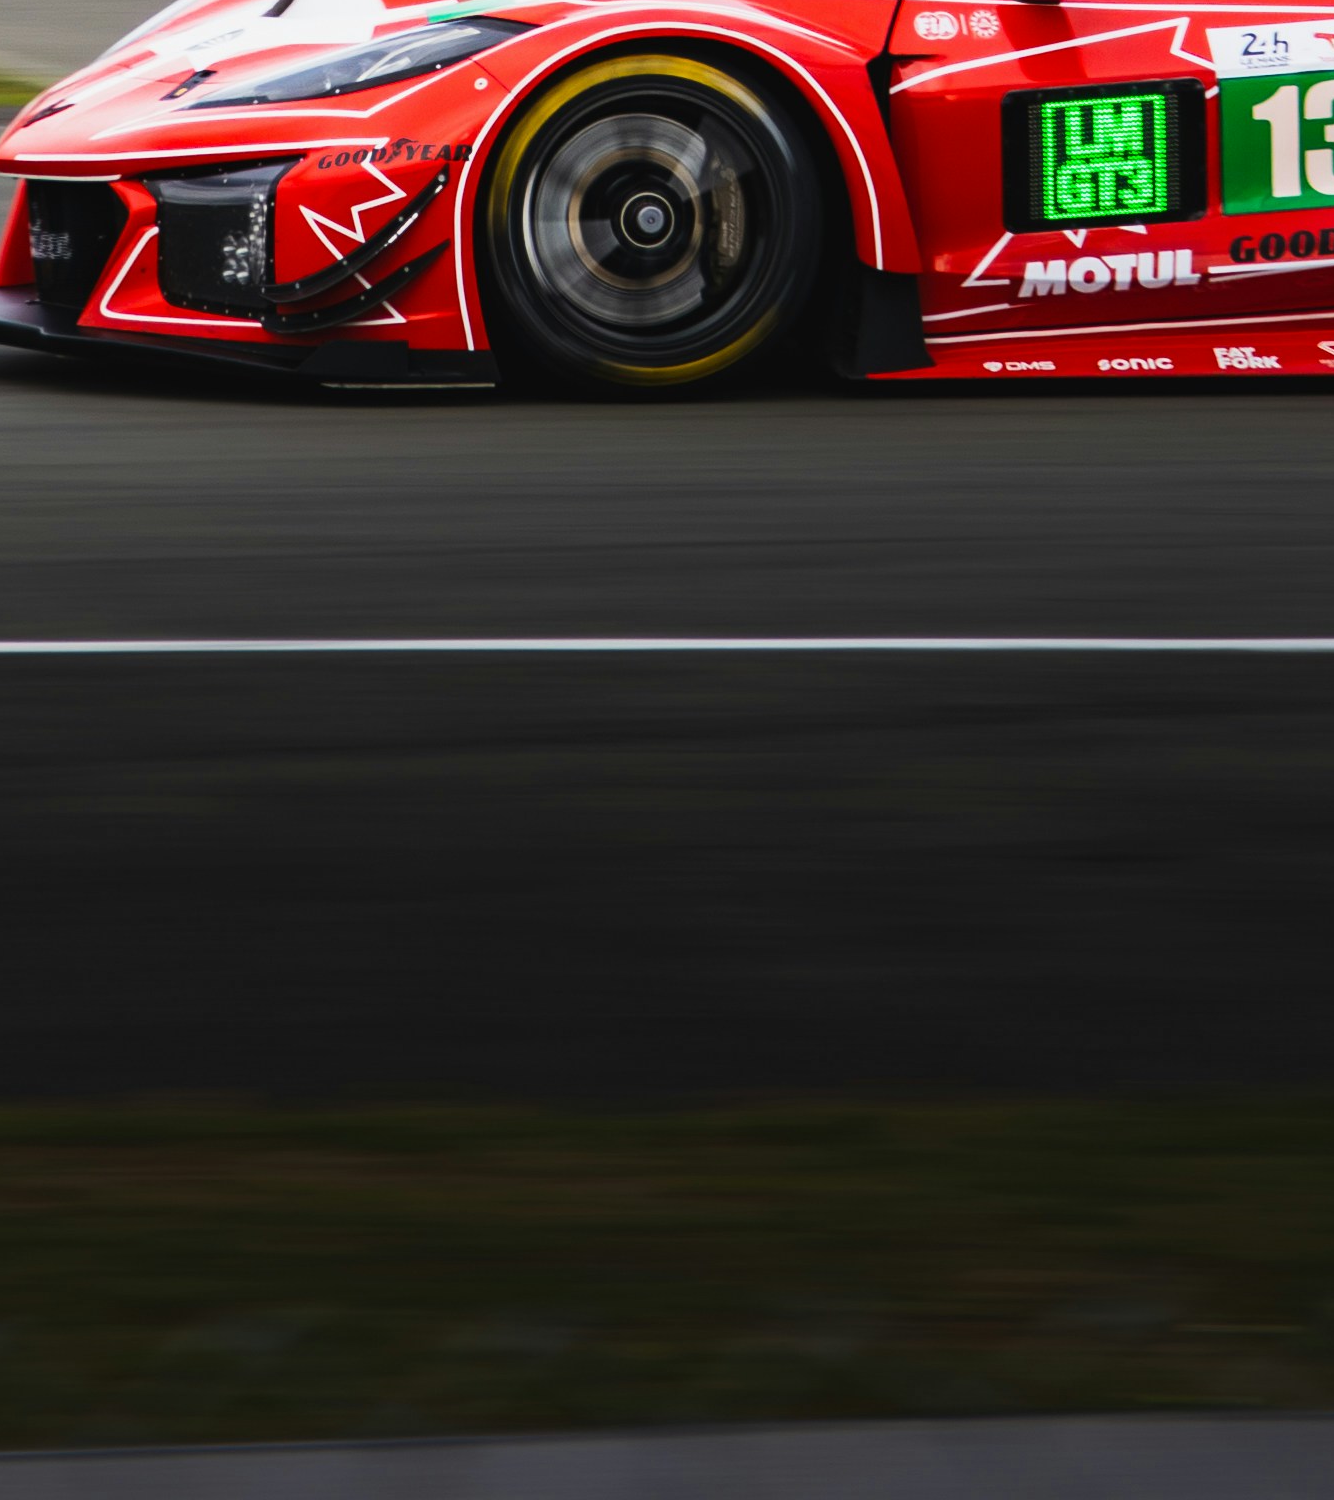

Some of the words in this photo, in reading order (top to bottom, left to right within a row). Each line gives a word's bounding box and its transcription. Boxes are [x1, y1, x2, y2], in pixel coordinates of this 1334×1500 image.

[1065, 101, 1144, 158] LM
[318, 142, 473, 170] GOODYEAR
[1056, 160, 1154, 212] GT3
[1018, 249, 1201, 298] MOTUL
[1005, 360, 1056, 372] DMS
[1213, 346, 1256, 358] FAT
[1216, 356, 1283, 370] FORK
